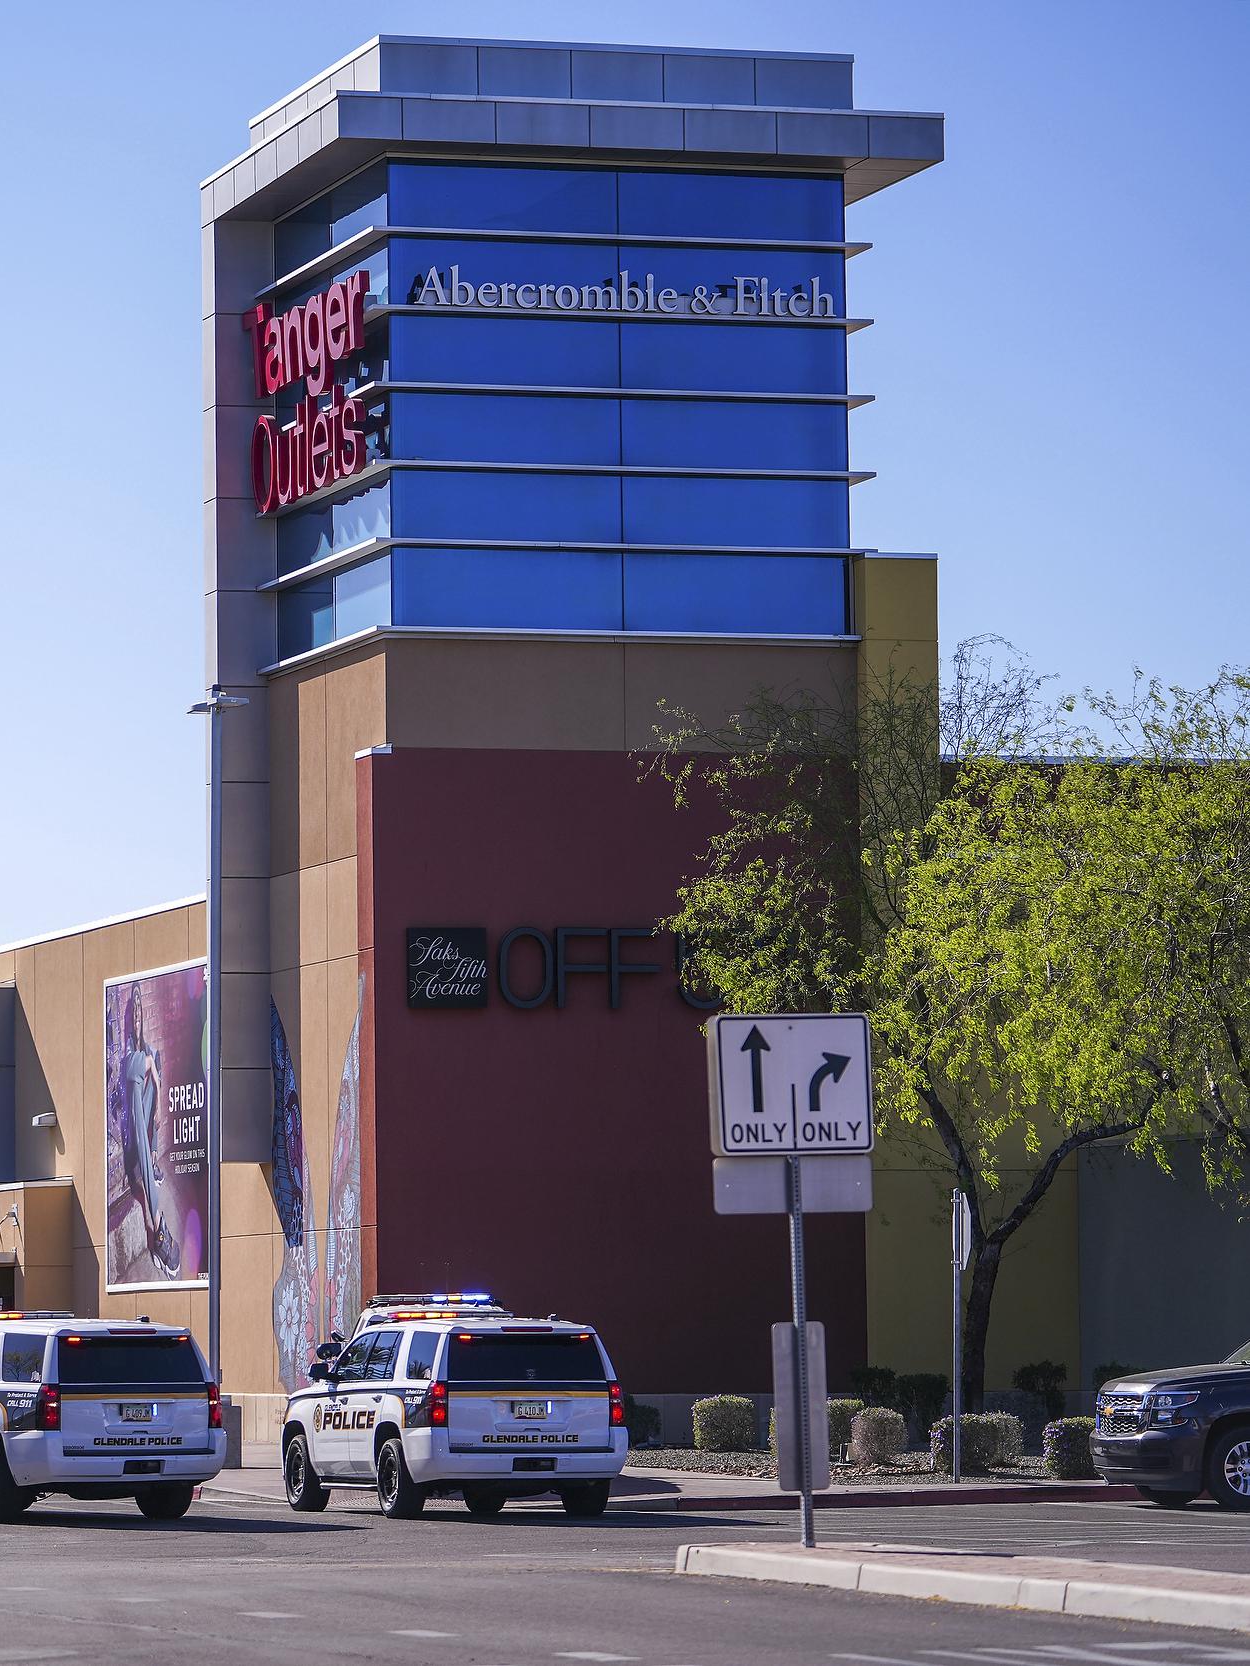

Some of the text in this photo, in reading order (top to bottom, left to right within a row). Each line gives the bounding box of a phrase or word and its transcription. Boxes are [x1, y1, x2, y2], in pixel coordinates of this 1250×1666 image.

[418, 265, 838, 317] Abercrombie & Fitch
[244, 270, 370, 397] Tanger
[252, 384, 366, 514] Outlets
[410, 936, 460, 966] Saks
[499, 926, 662, 1009] OFF
[410, 970, 481, 999] Avenue
[168, 1082, 204, 1112] SPREAD
[173, 1116, 201, 1144] LIGHT
[731, 1122, 787, 1143] ONLY
[802, 1121, 862, 1142] ONLY
[6, 1399, 33, 1408] CALL 911
[322, 1410, 376, 1430] POLICE
[93, 1437, 182, 1446] GLENDALE POLICE
[483, 1434, 579, 1443] GLENDALE POLICE
